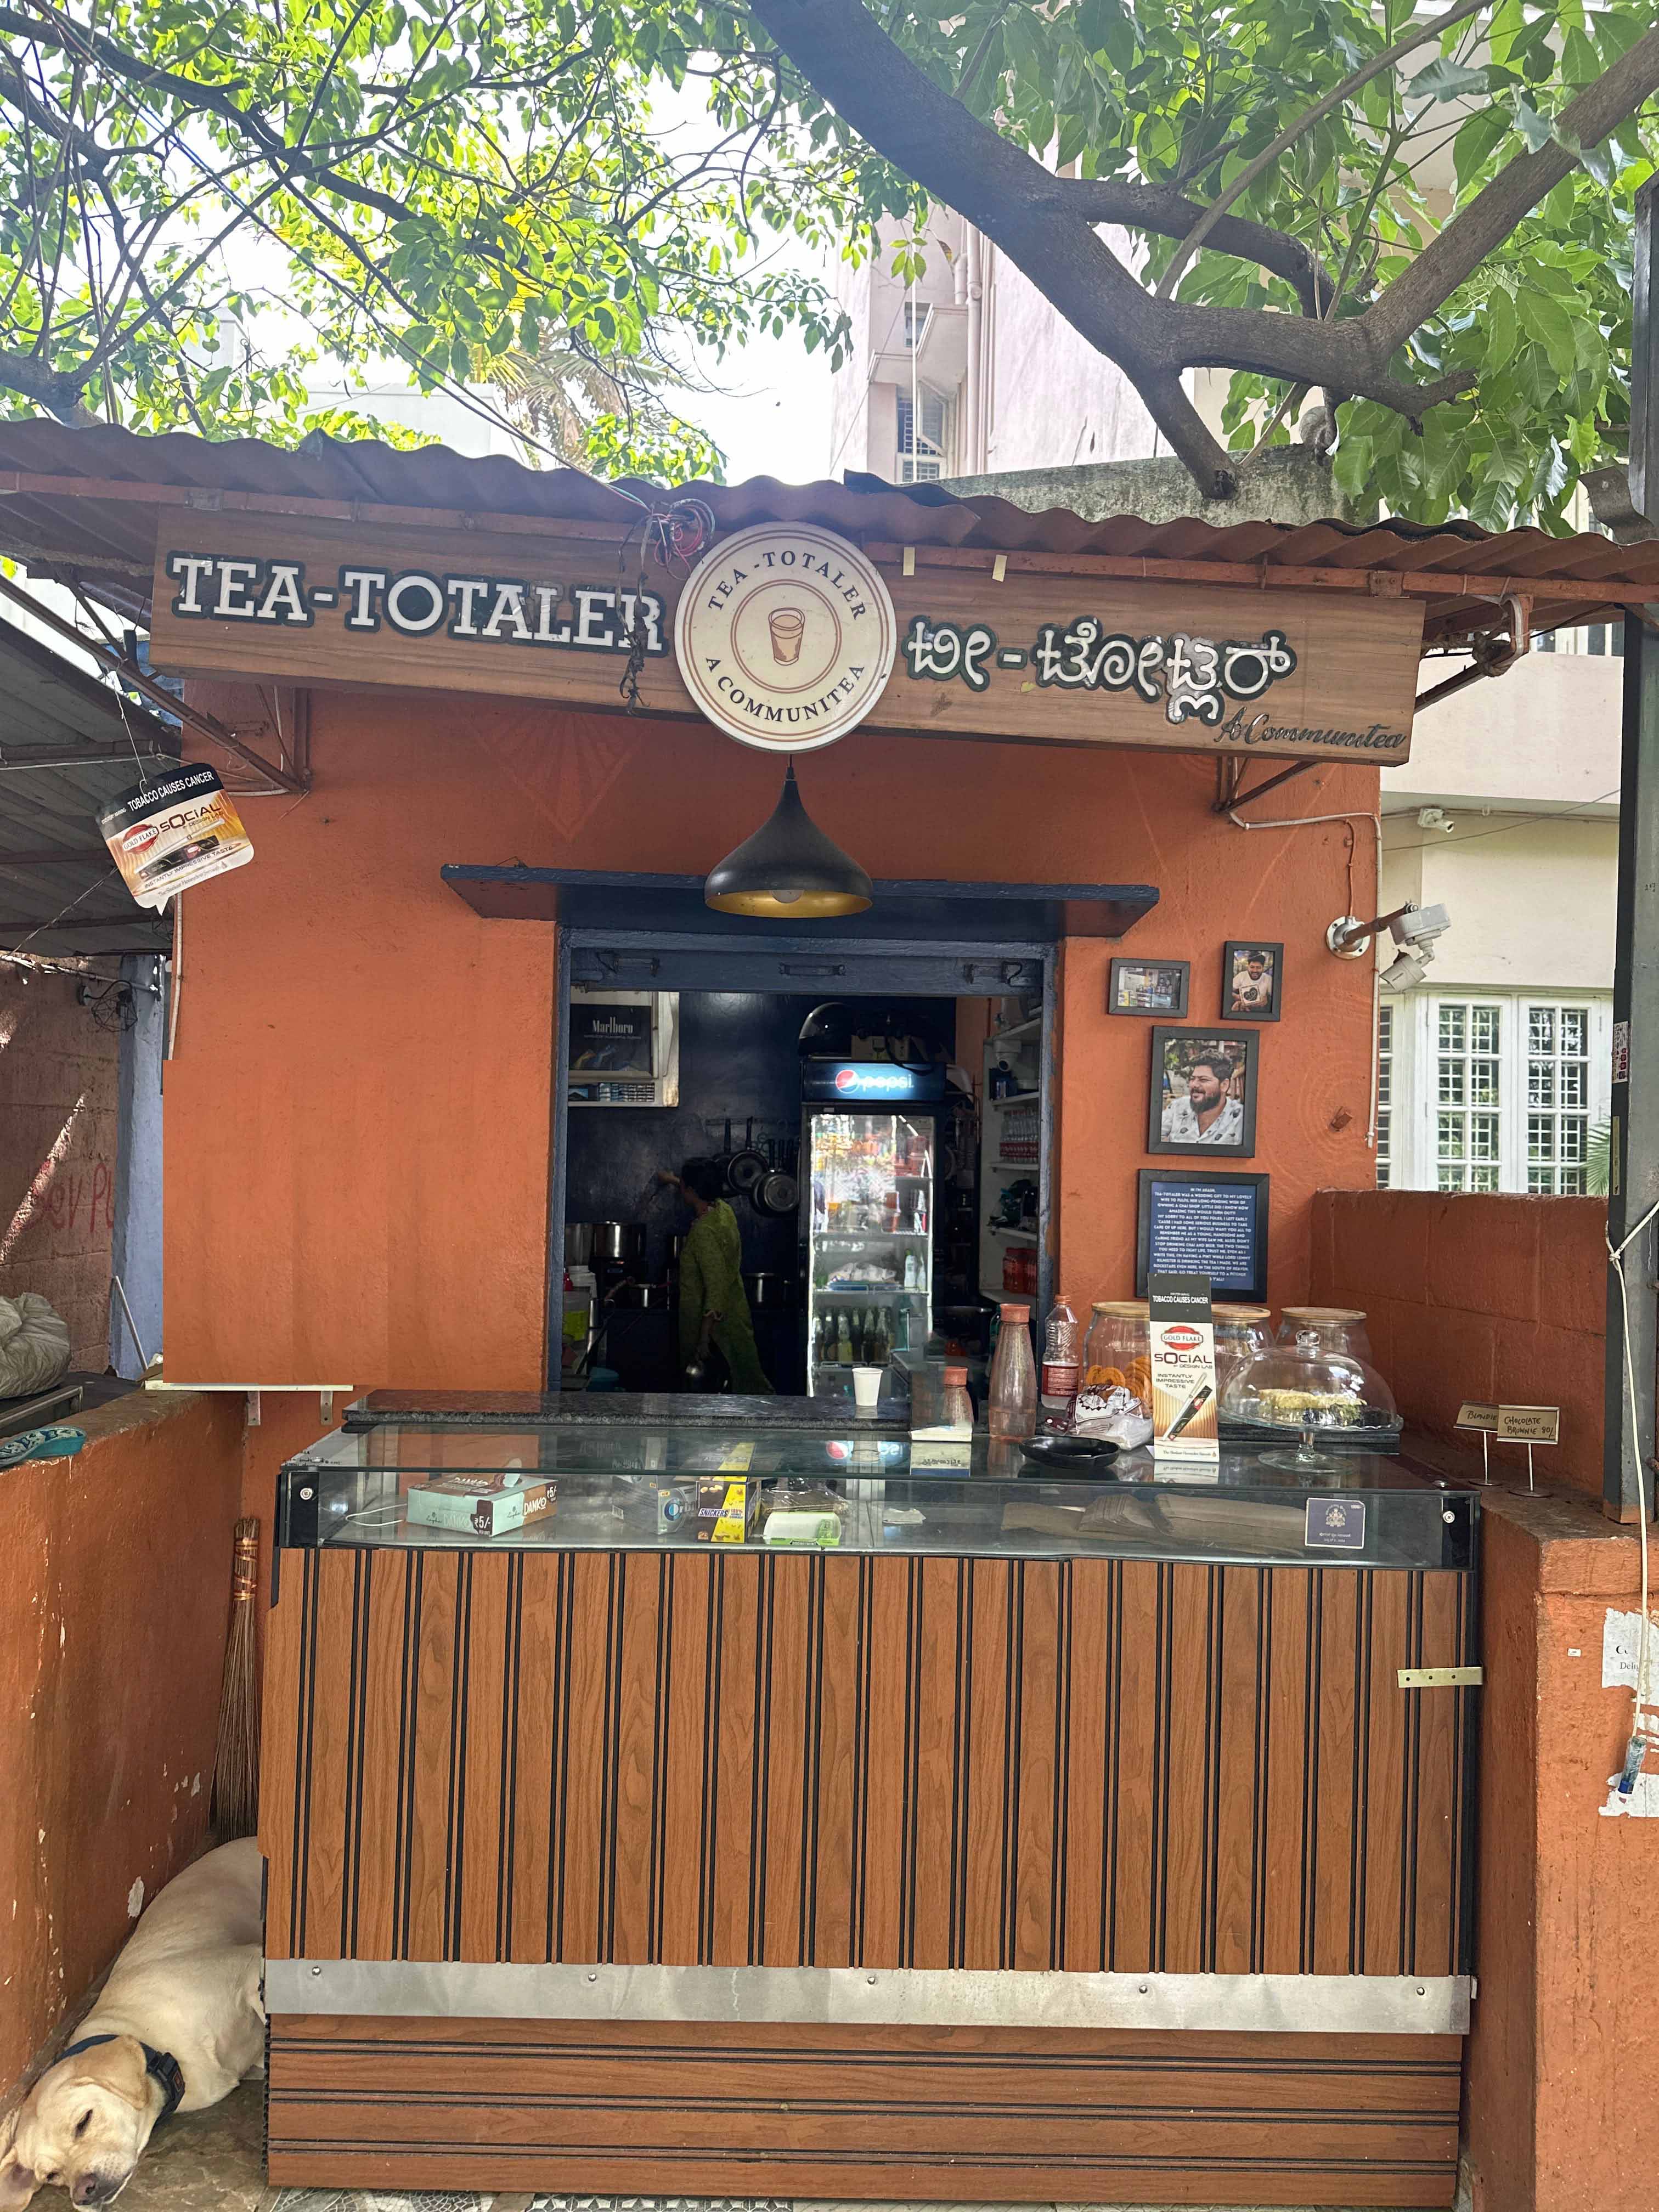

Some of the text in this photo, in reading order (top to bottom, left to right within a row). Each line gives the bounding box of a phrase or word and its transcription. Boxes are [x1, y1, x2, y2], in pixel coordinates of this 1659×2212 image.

[170, 554, 664, 653] TEA-TOTALER
[706, 657, 865, 722] A COMMUNITEA
[1244, 713, 1406, 748] Communitea
[127, 771, 215, 812] TOBACCO CAUSES CANCER
[123, 829, 157, 850] GOLD FLAKE
[144, 871, 173, 888] INSTANTLY
[212, 846, 233, 856] TASTE
[592, 1017, 633, 1034] Marlboro
[860, 1074, 915, 1092] pepsi
[1504, 1415, 1541, 1426] CHOCOLATE
[1507, 1425, 1537, 1436] BROWNIE
[524, 1497, 547, 1516] DANKO
[700, 1509, 729, 1517] SNICKERS
[443, 1514, 471, 1528] DANKO
